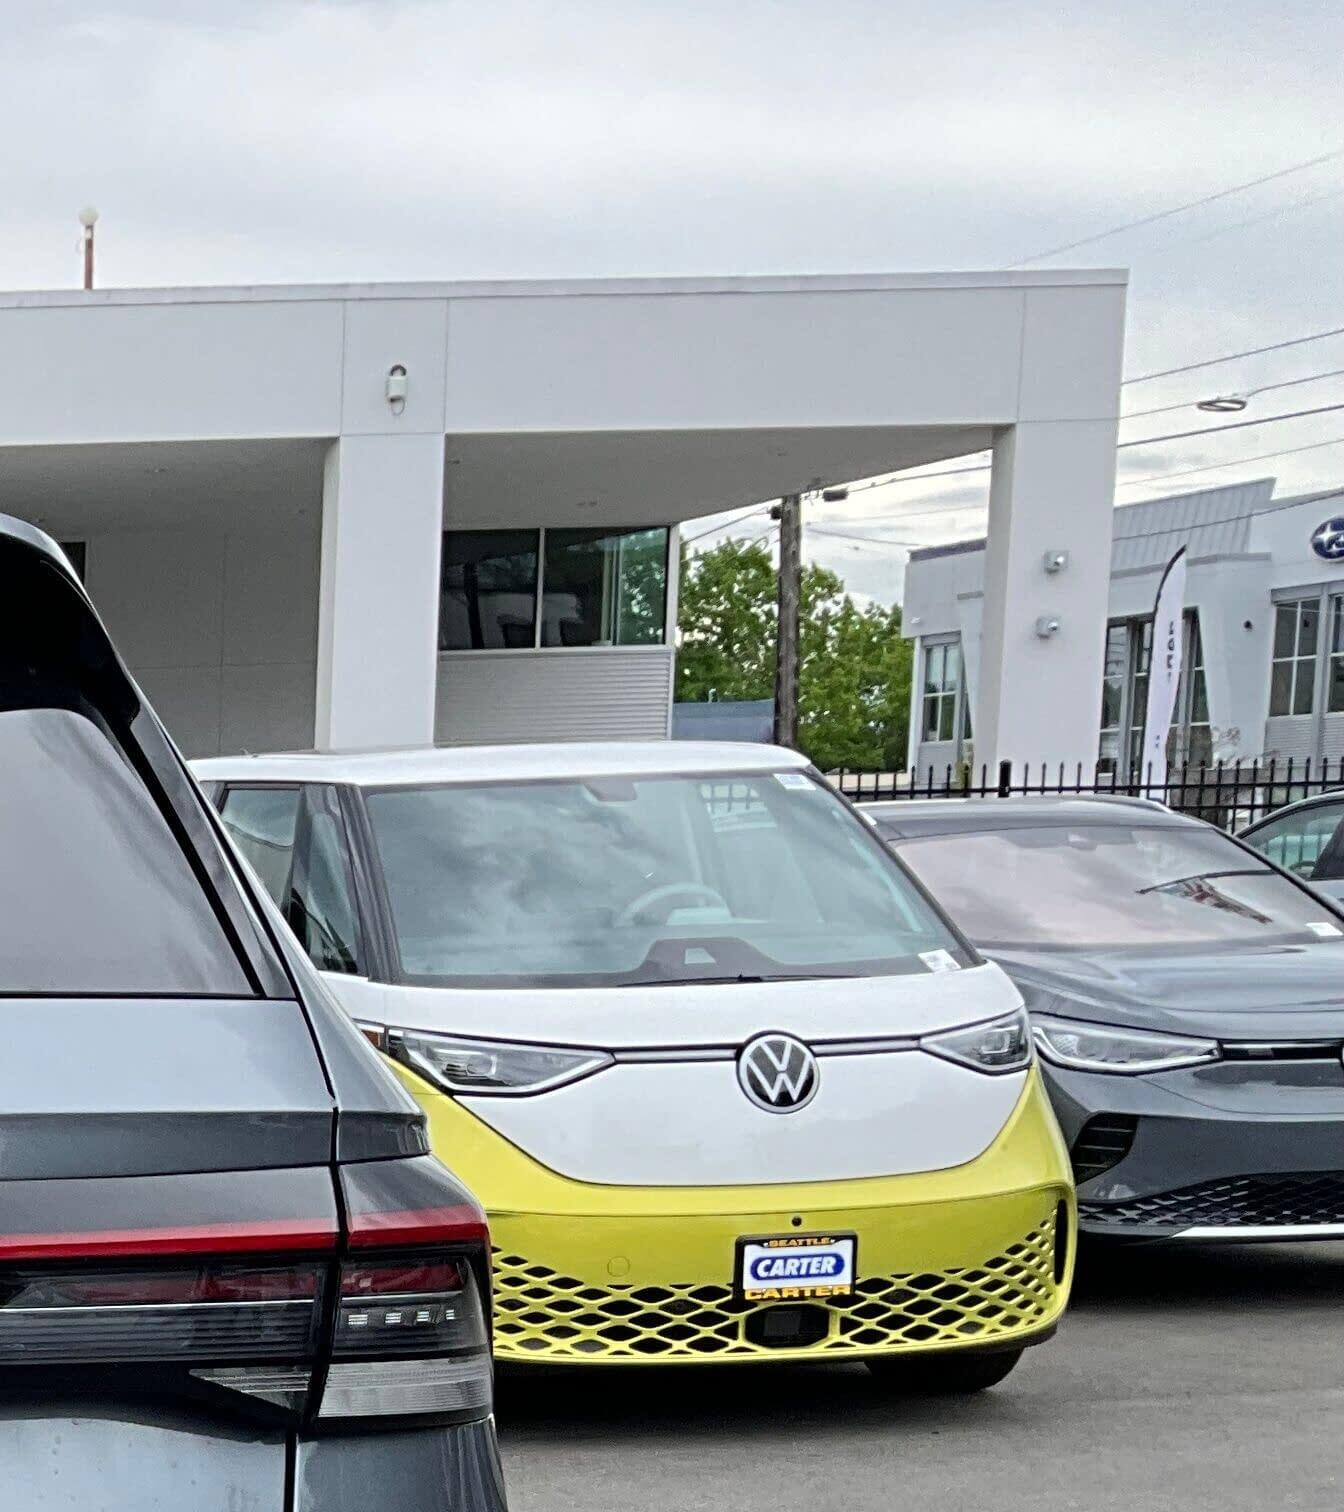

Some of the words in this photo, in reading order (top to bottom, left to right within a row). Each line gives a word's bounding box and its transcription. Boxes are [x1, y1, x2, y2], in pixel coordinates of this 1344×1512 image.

[768, 1237, 832, 1248] SEATTLE
[756, 1255, 838, 1278] CARTER
[744, 1285, 852, 1301] CARTER
